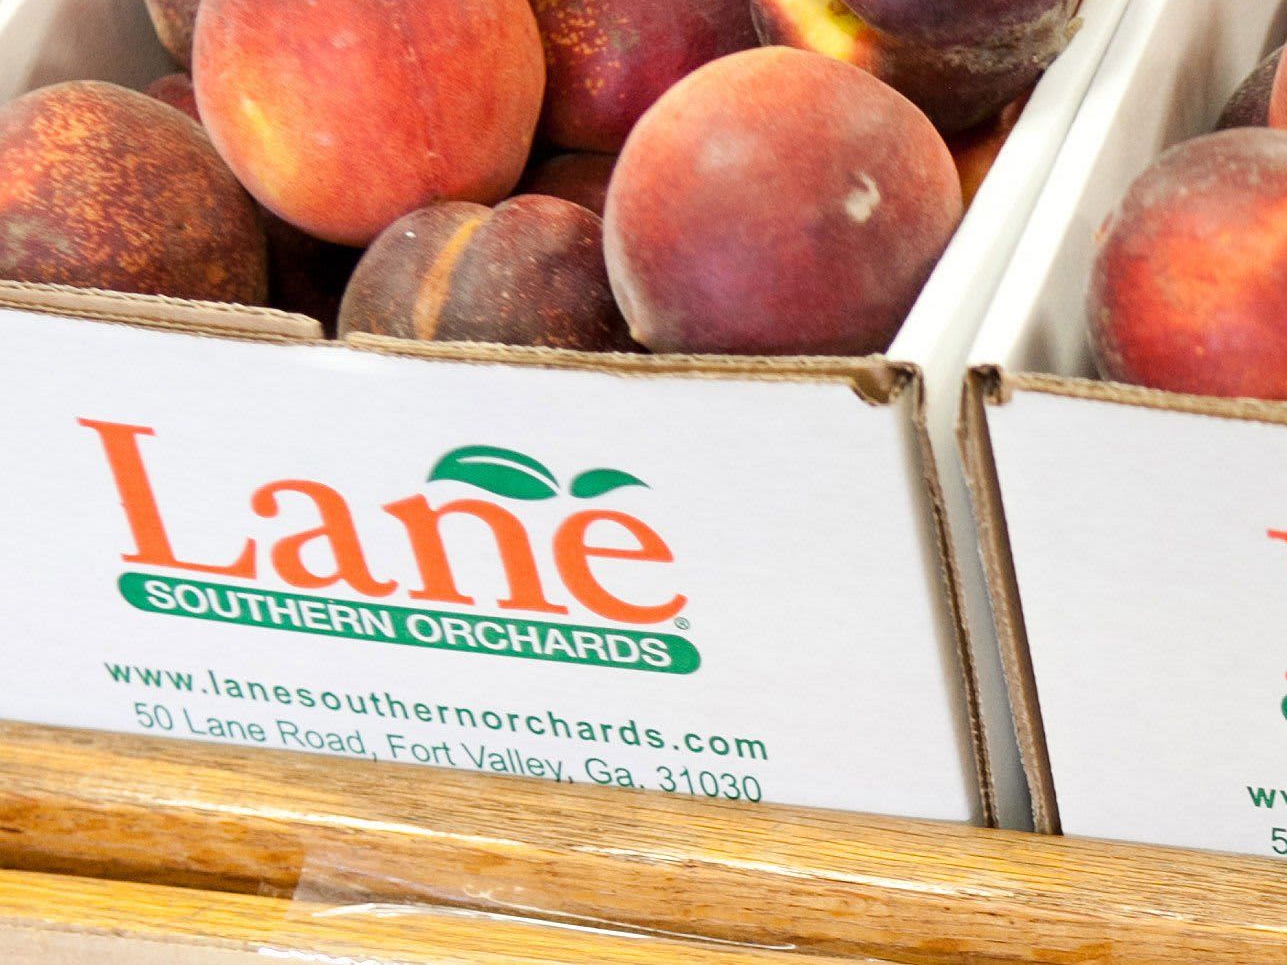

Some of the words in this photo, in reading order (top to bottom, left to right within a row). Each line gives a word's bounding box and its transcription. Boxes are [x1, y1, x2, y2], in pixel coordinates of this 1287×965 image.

[77, 417, 688, 624] Lane
[144, 578, 397, 639] SOUTHERN
[407, 612, 673, 668] ORCHARDS
[104, 662, 768, 760] www.lanesouthernorchards.com
[134, 702, 173, 731] 50
[183, 708, 266, 742] Lane
[276, 720, 377, 762] Road,
[386, 734, 456, 766] Fort
[461, 742, 574, 785] Valley,
[584, 757, 645, 790] Ga.
[656, 766, 762, 803] 31030
